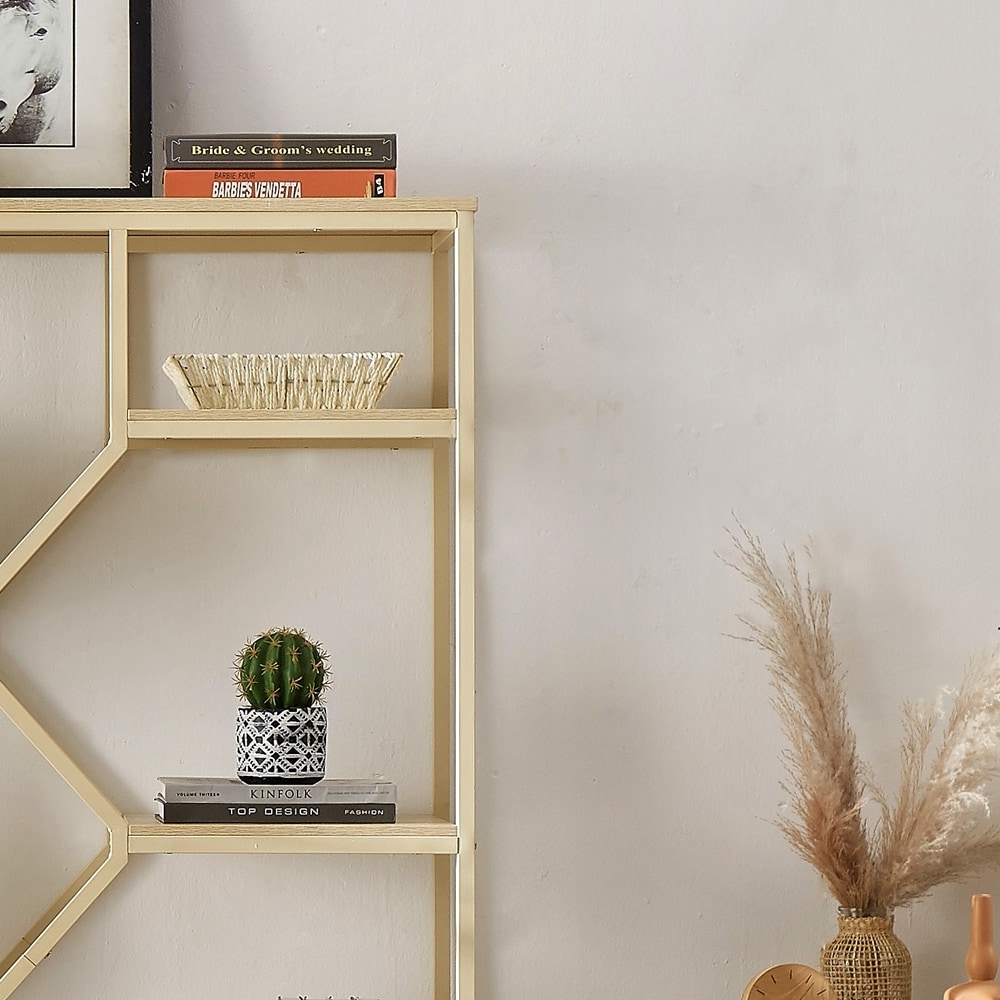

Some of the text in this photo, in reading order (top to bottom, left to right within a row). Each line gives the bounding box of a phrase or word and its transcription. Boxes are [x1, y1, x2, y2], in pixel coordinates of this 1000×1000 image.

[191, 144, 372, 156] Bride & Groom's wedding
[214, 172, 256, 180] BARBIE FOUR
[254, 181, 302, 198] VENDETTA
[250, 788, 312, 799] KINFOLK
